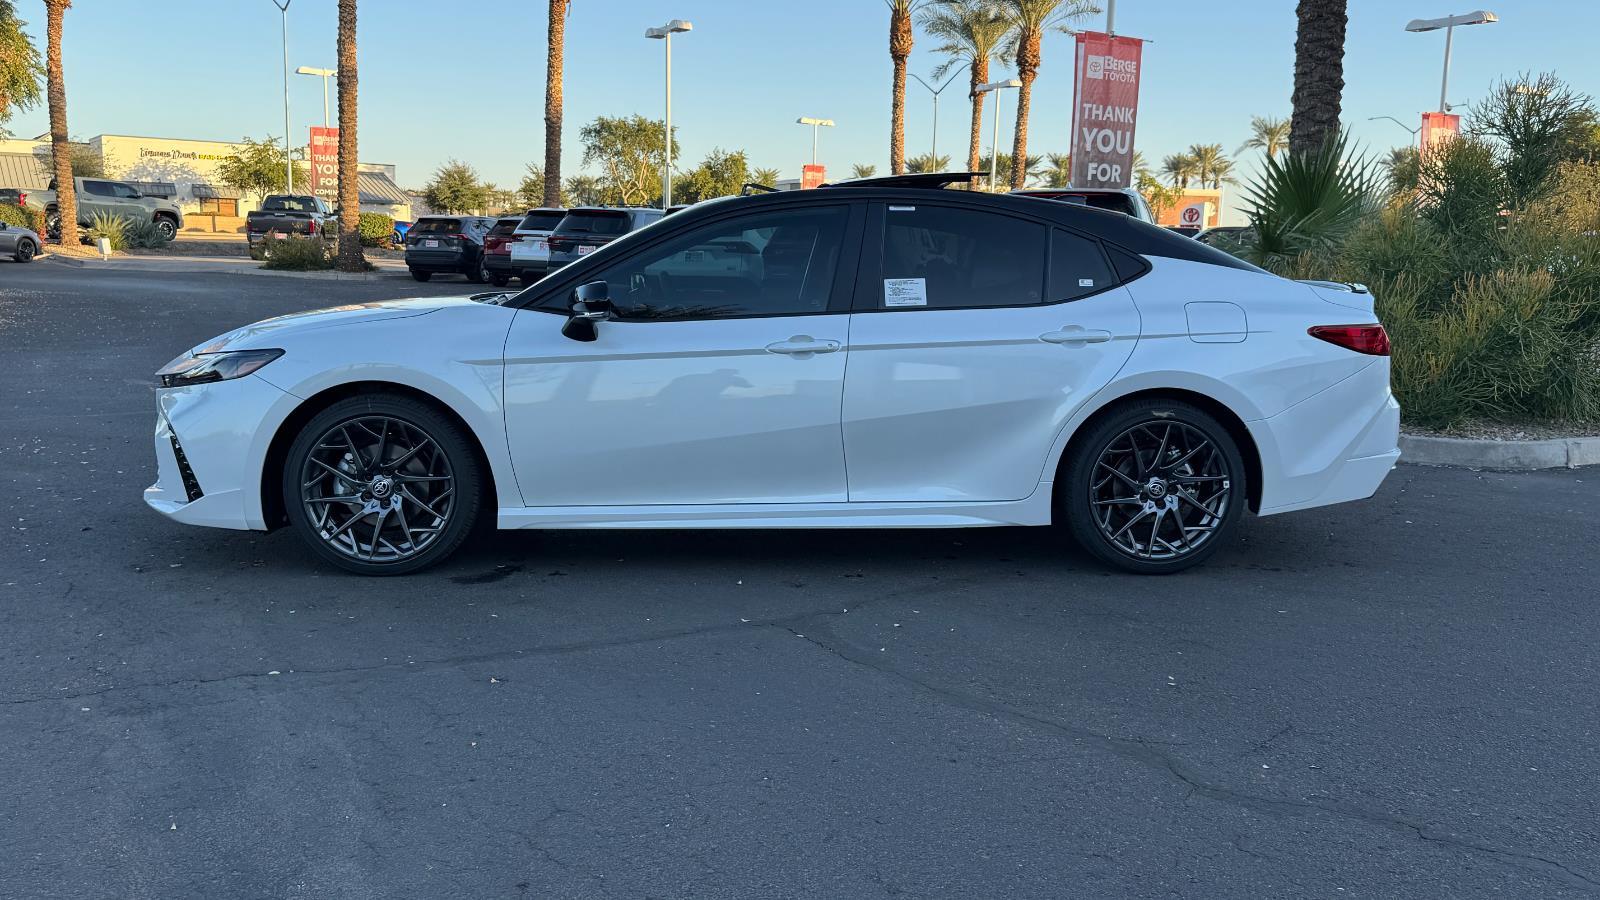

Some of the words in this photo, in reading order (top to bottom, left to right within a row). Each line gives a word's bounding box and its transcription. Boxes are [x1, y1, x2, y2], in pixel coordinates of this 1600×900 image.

[1104, 56, 1136, 73] BERGE
[1104, 72, 1136, 84] TOYOTA
[1083, 103, 1134, 124] THANK
[1082, 127, 1130, 155] YOU
[314, 154, 338, 162] THAN
[1087, 162, 1121, 183] FOR
[315, 188, 338, 196] COMIN
